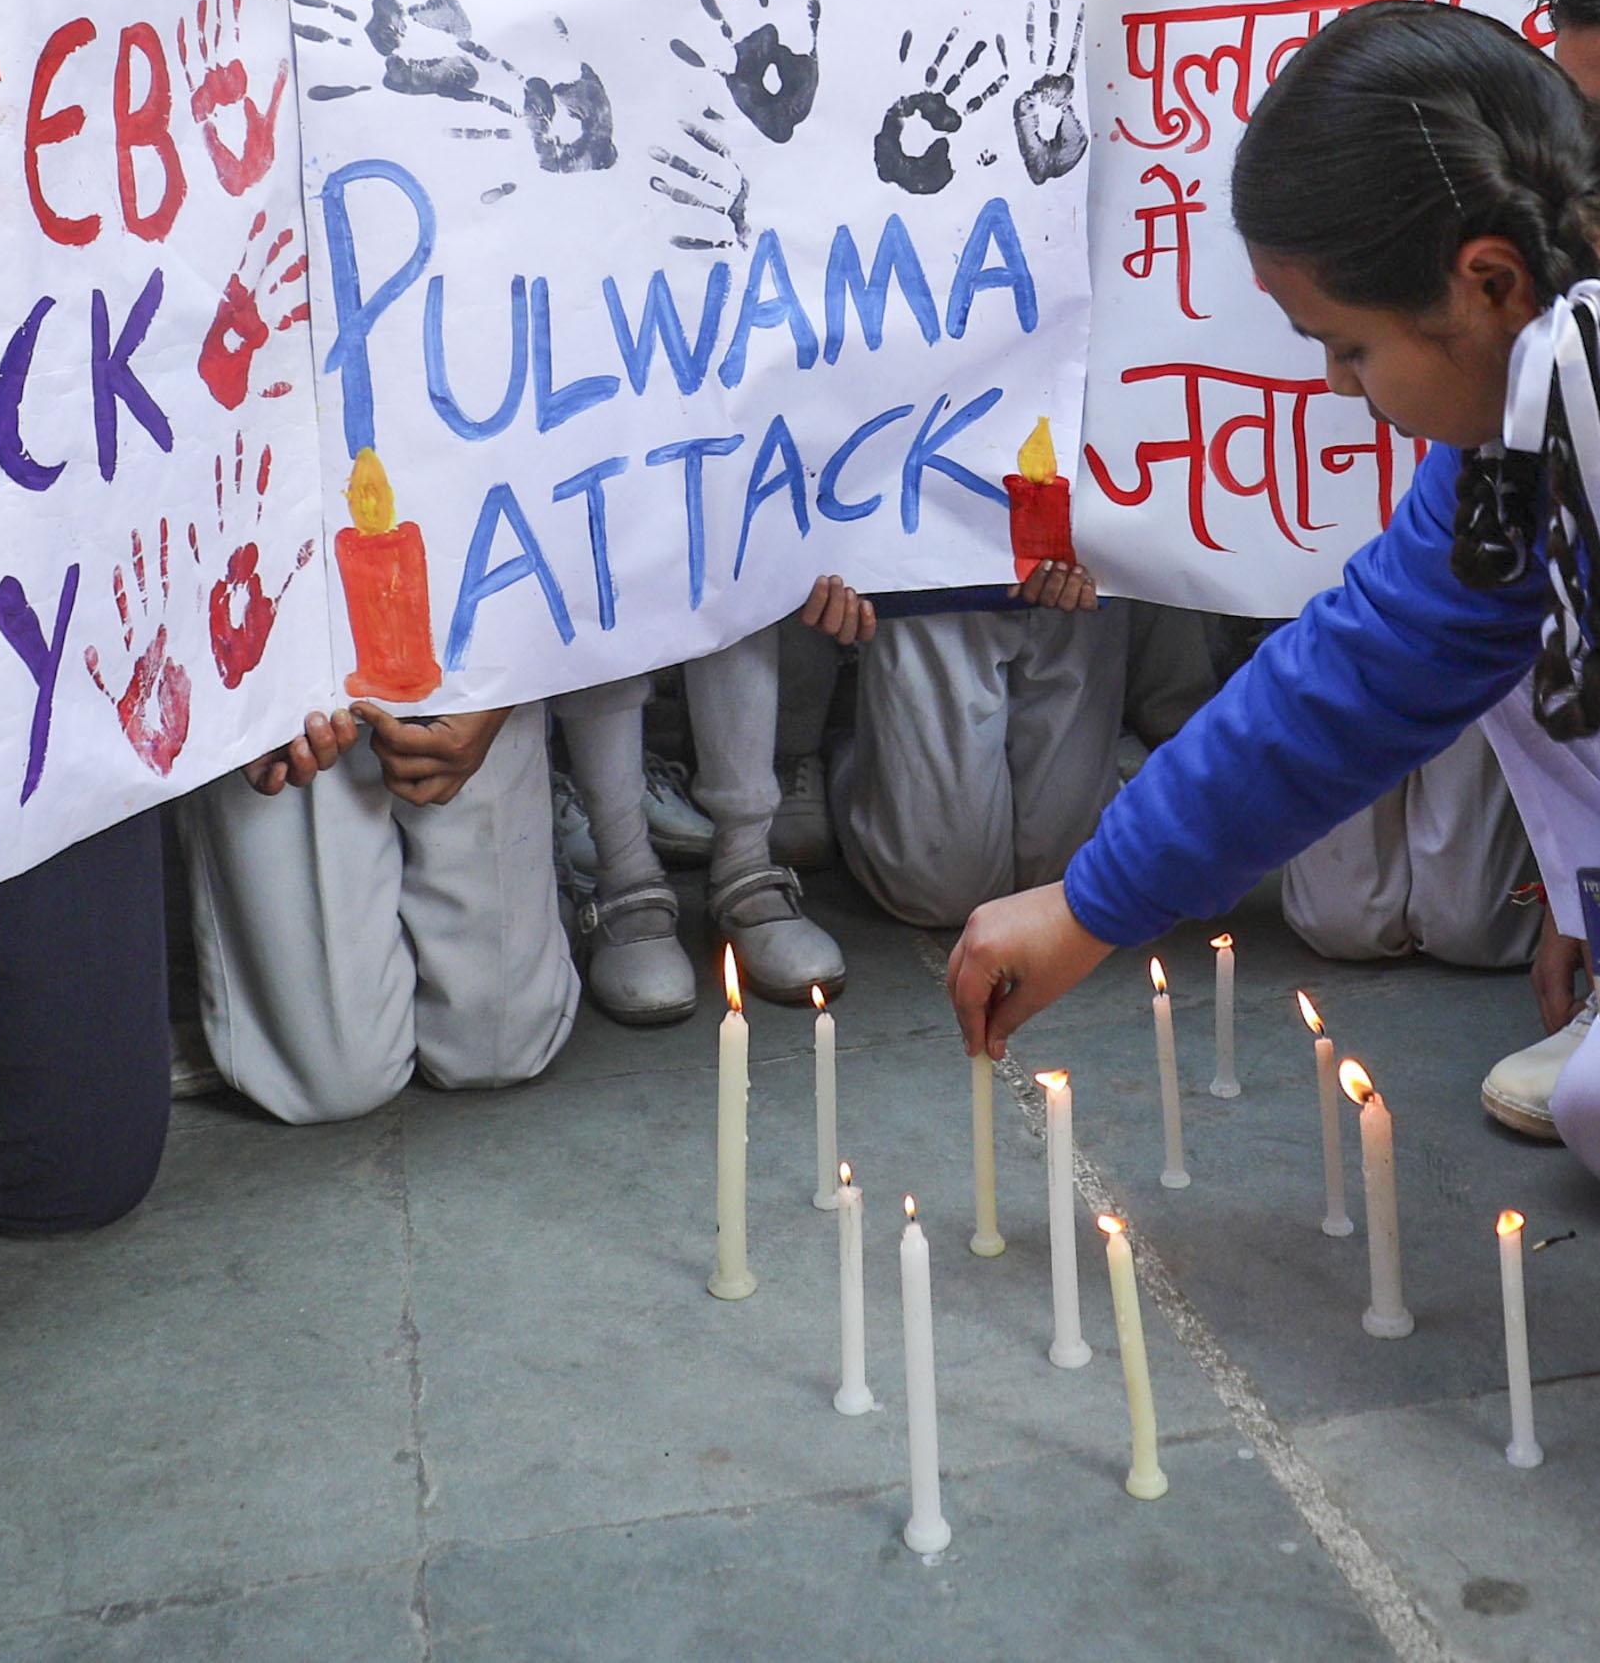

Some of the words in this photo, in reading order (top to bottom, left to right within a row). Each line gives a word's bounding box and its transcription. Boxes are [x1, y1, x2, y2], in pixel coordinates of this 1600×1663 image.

[312, 158, 1041, 460] PULWAMA
[1122, 164, 1213, 321] में
[444, 387, 1012, 672] ATTACK
